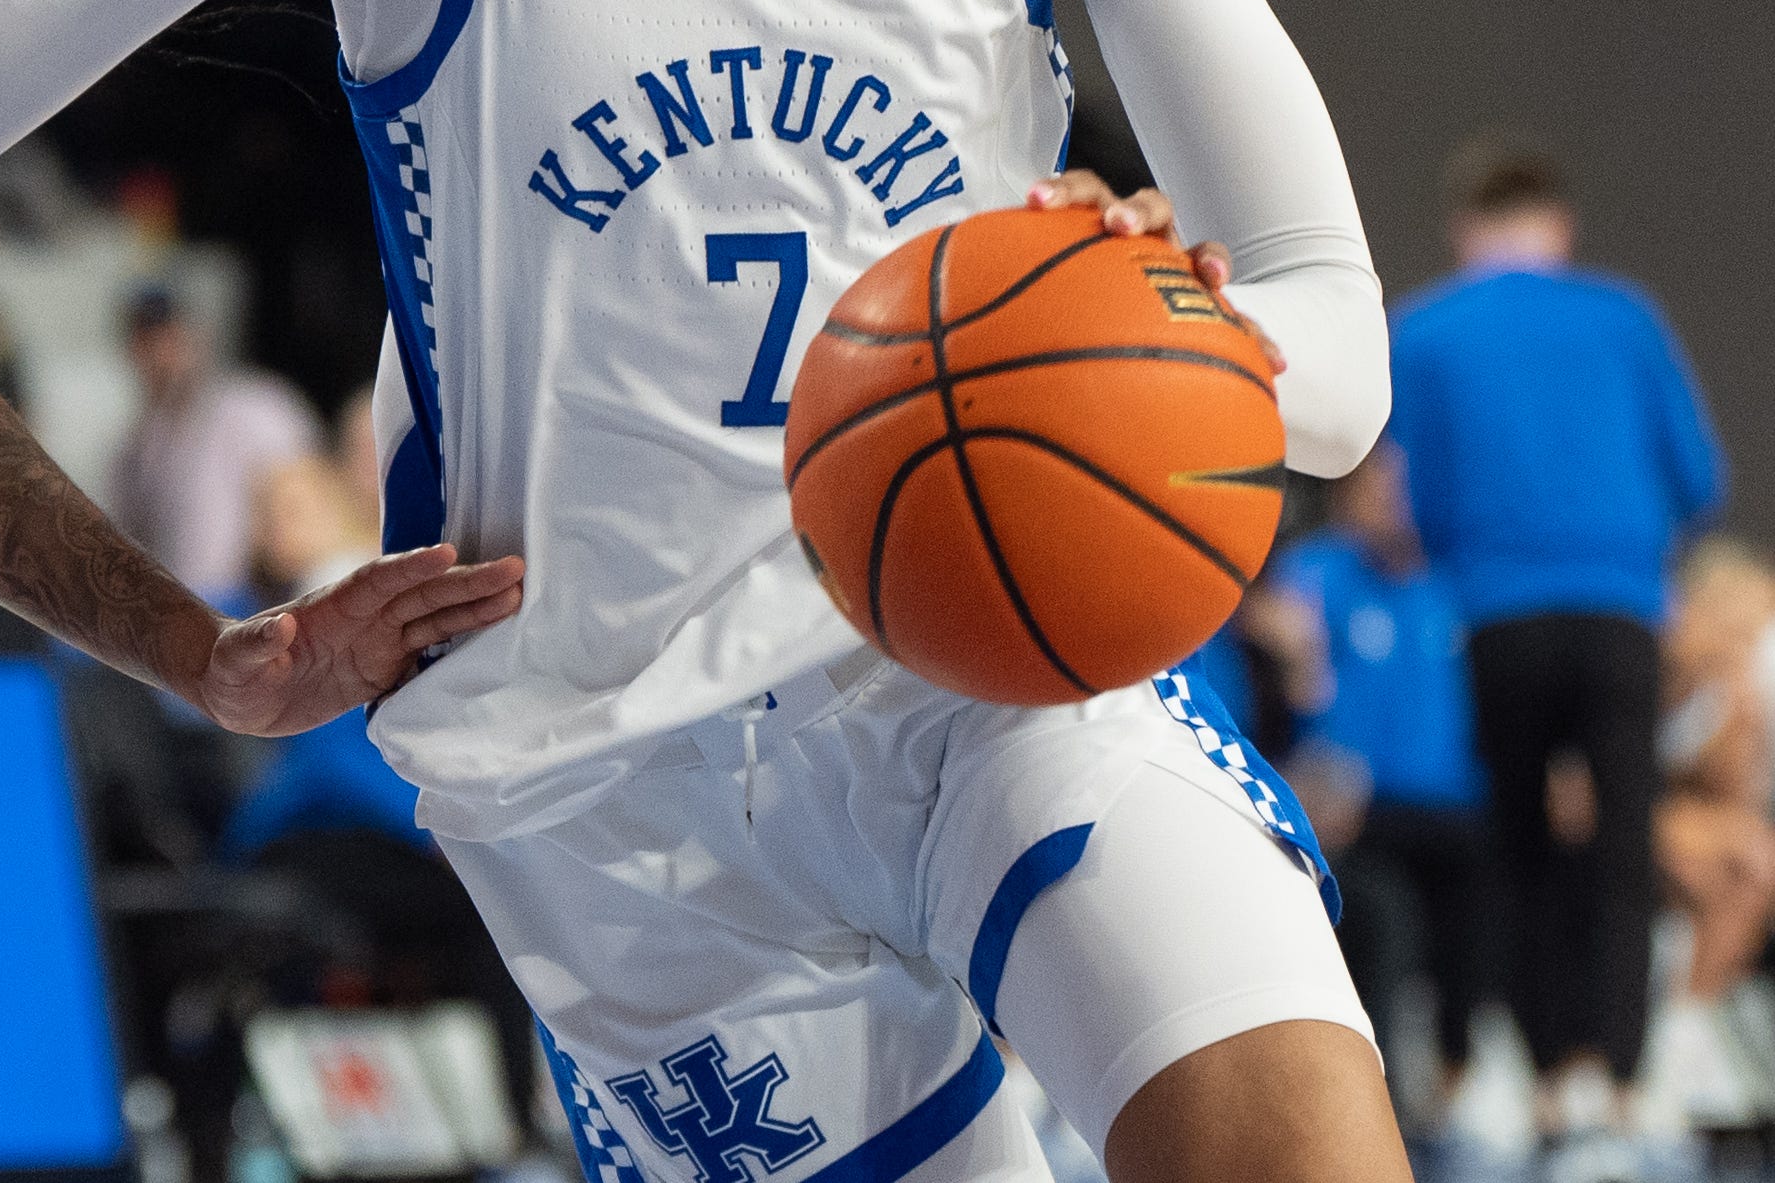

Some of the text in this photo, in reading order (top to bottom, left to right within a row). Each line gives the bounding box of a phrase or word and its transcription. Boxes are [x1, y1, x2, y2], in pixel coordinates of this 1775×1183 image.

[527, 46, 965, 235] KENTUCKY
[704, 231, 810, 429] 7
[604, 1034, 827, 1183] UK
